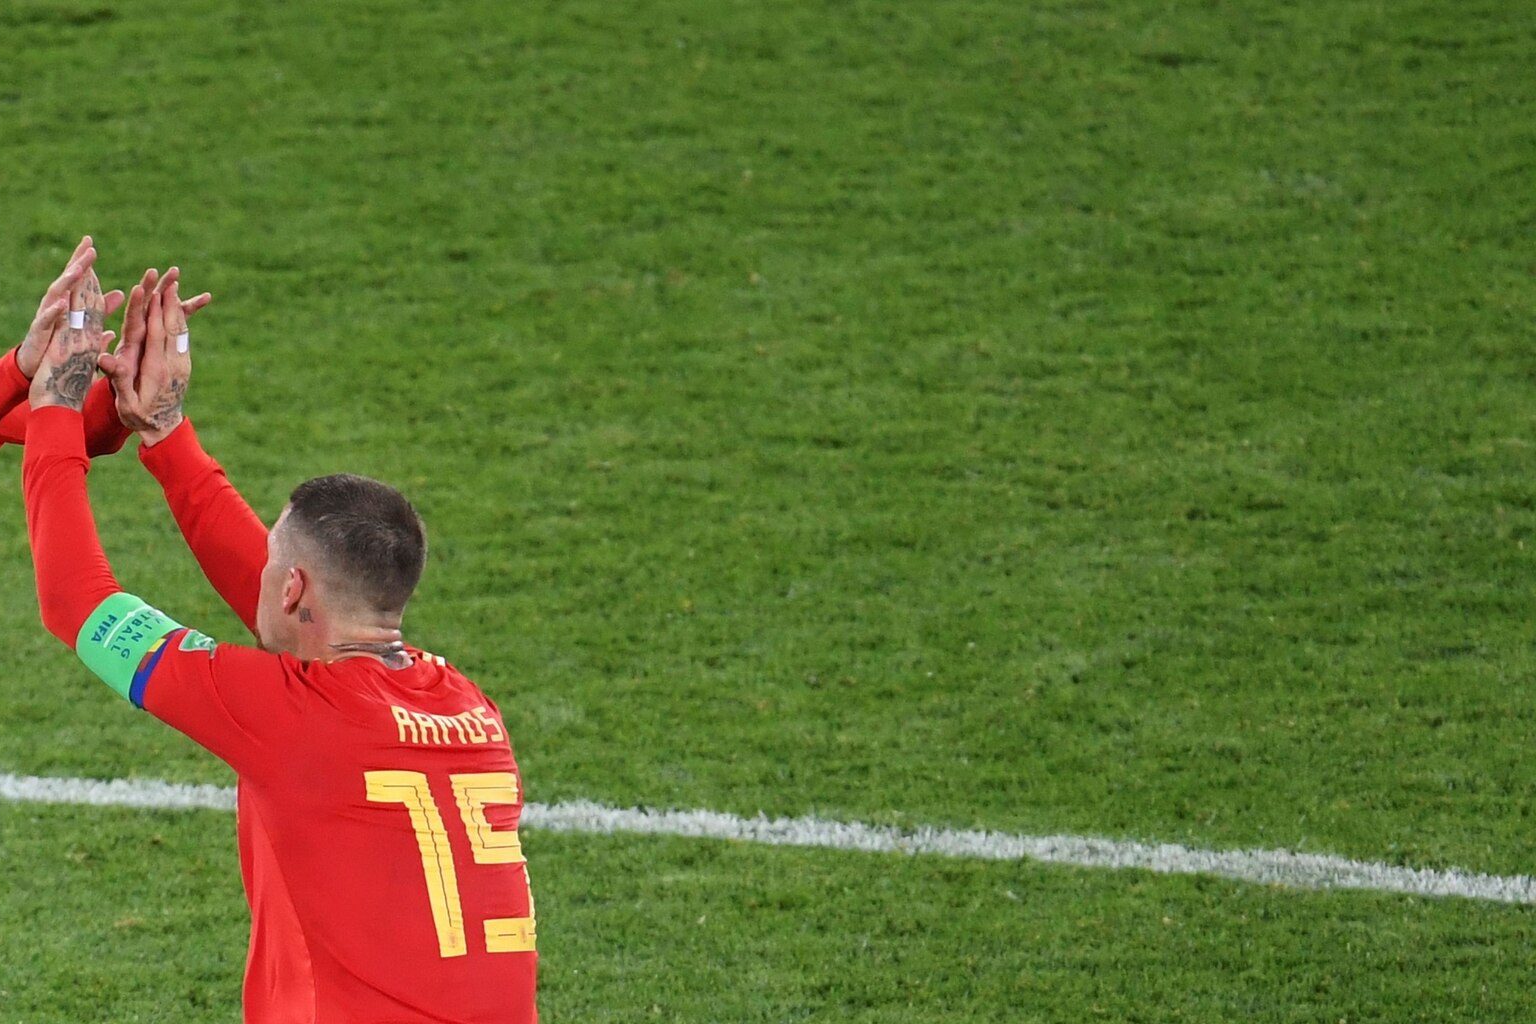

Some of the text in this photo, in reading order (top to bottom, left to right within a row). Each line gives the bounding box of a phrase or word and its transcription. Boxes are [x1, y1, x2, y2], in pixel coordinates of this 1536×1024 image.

[90, 613, 118, 643] FIFA
[390, 705, 504, 745] RAMOS
[364, 770, 537, 958] 15
